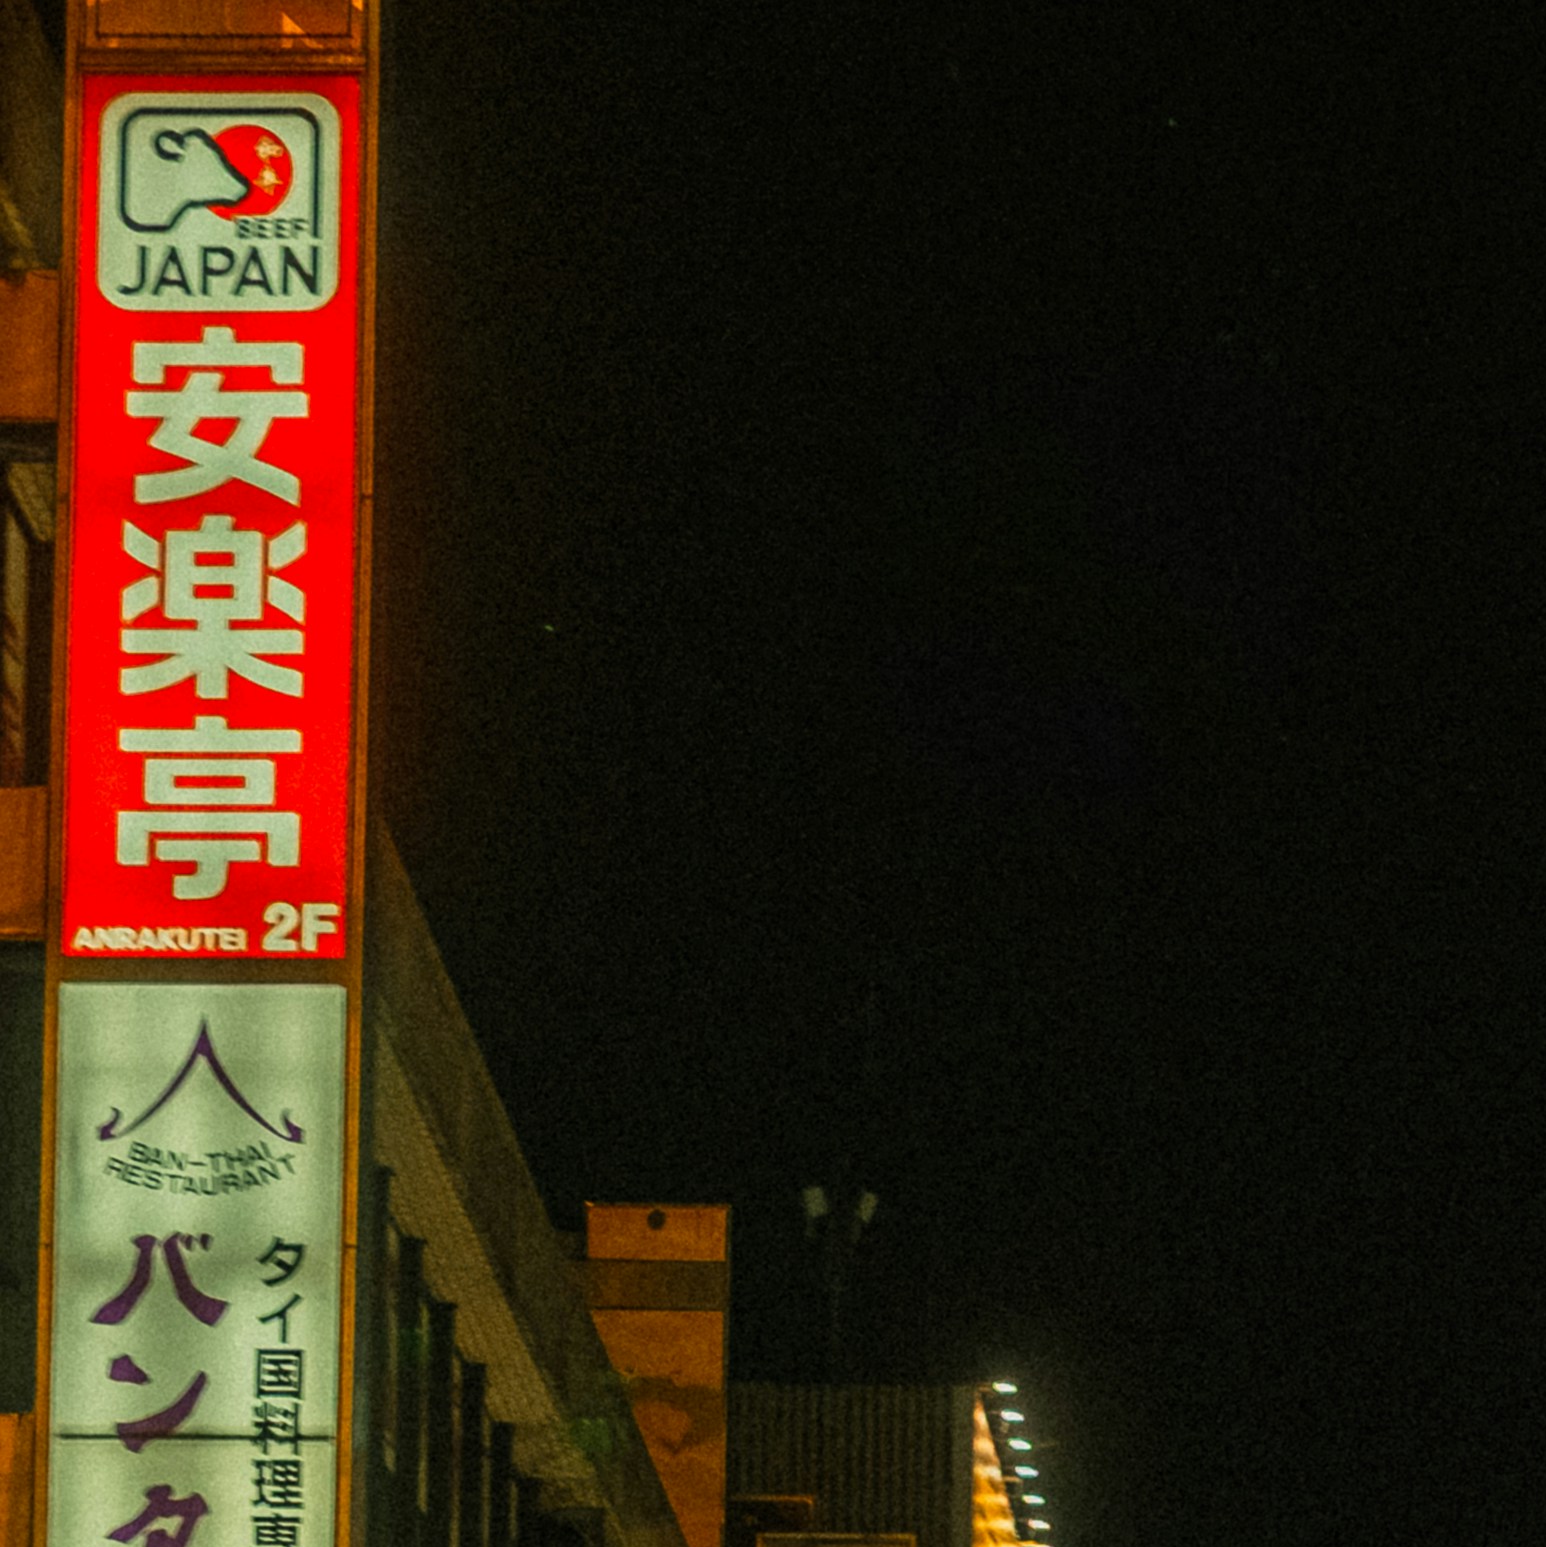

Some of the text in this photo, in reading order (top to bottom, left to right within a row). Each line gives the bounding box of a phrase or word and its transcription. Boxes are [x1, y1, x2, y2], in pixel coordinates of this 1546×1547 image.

[236, 217, 306, 239] BEEF
[117, 245, 322, 298] JAPAN
[115, 326, 311, 901] 安楽亭
[71, 903, 341, 953] ANRAKUTEI 2F
[127, 1140, 276, 1172] BAN-THAI
